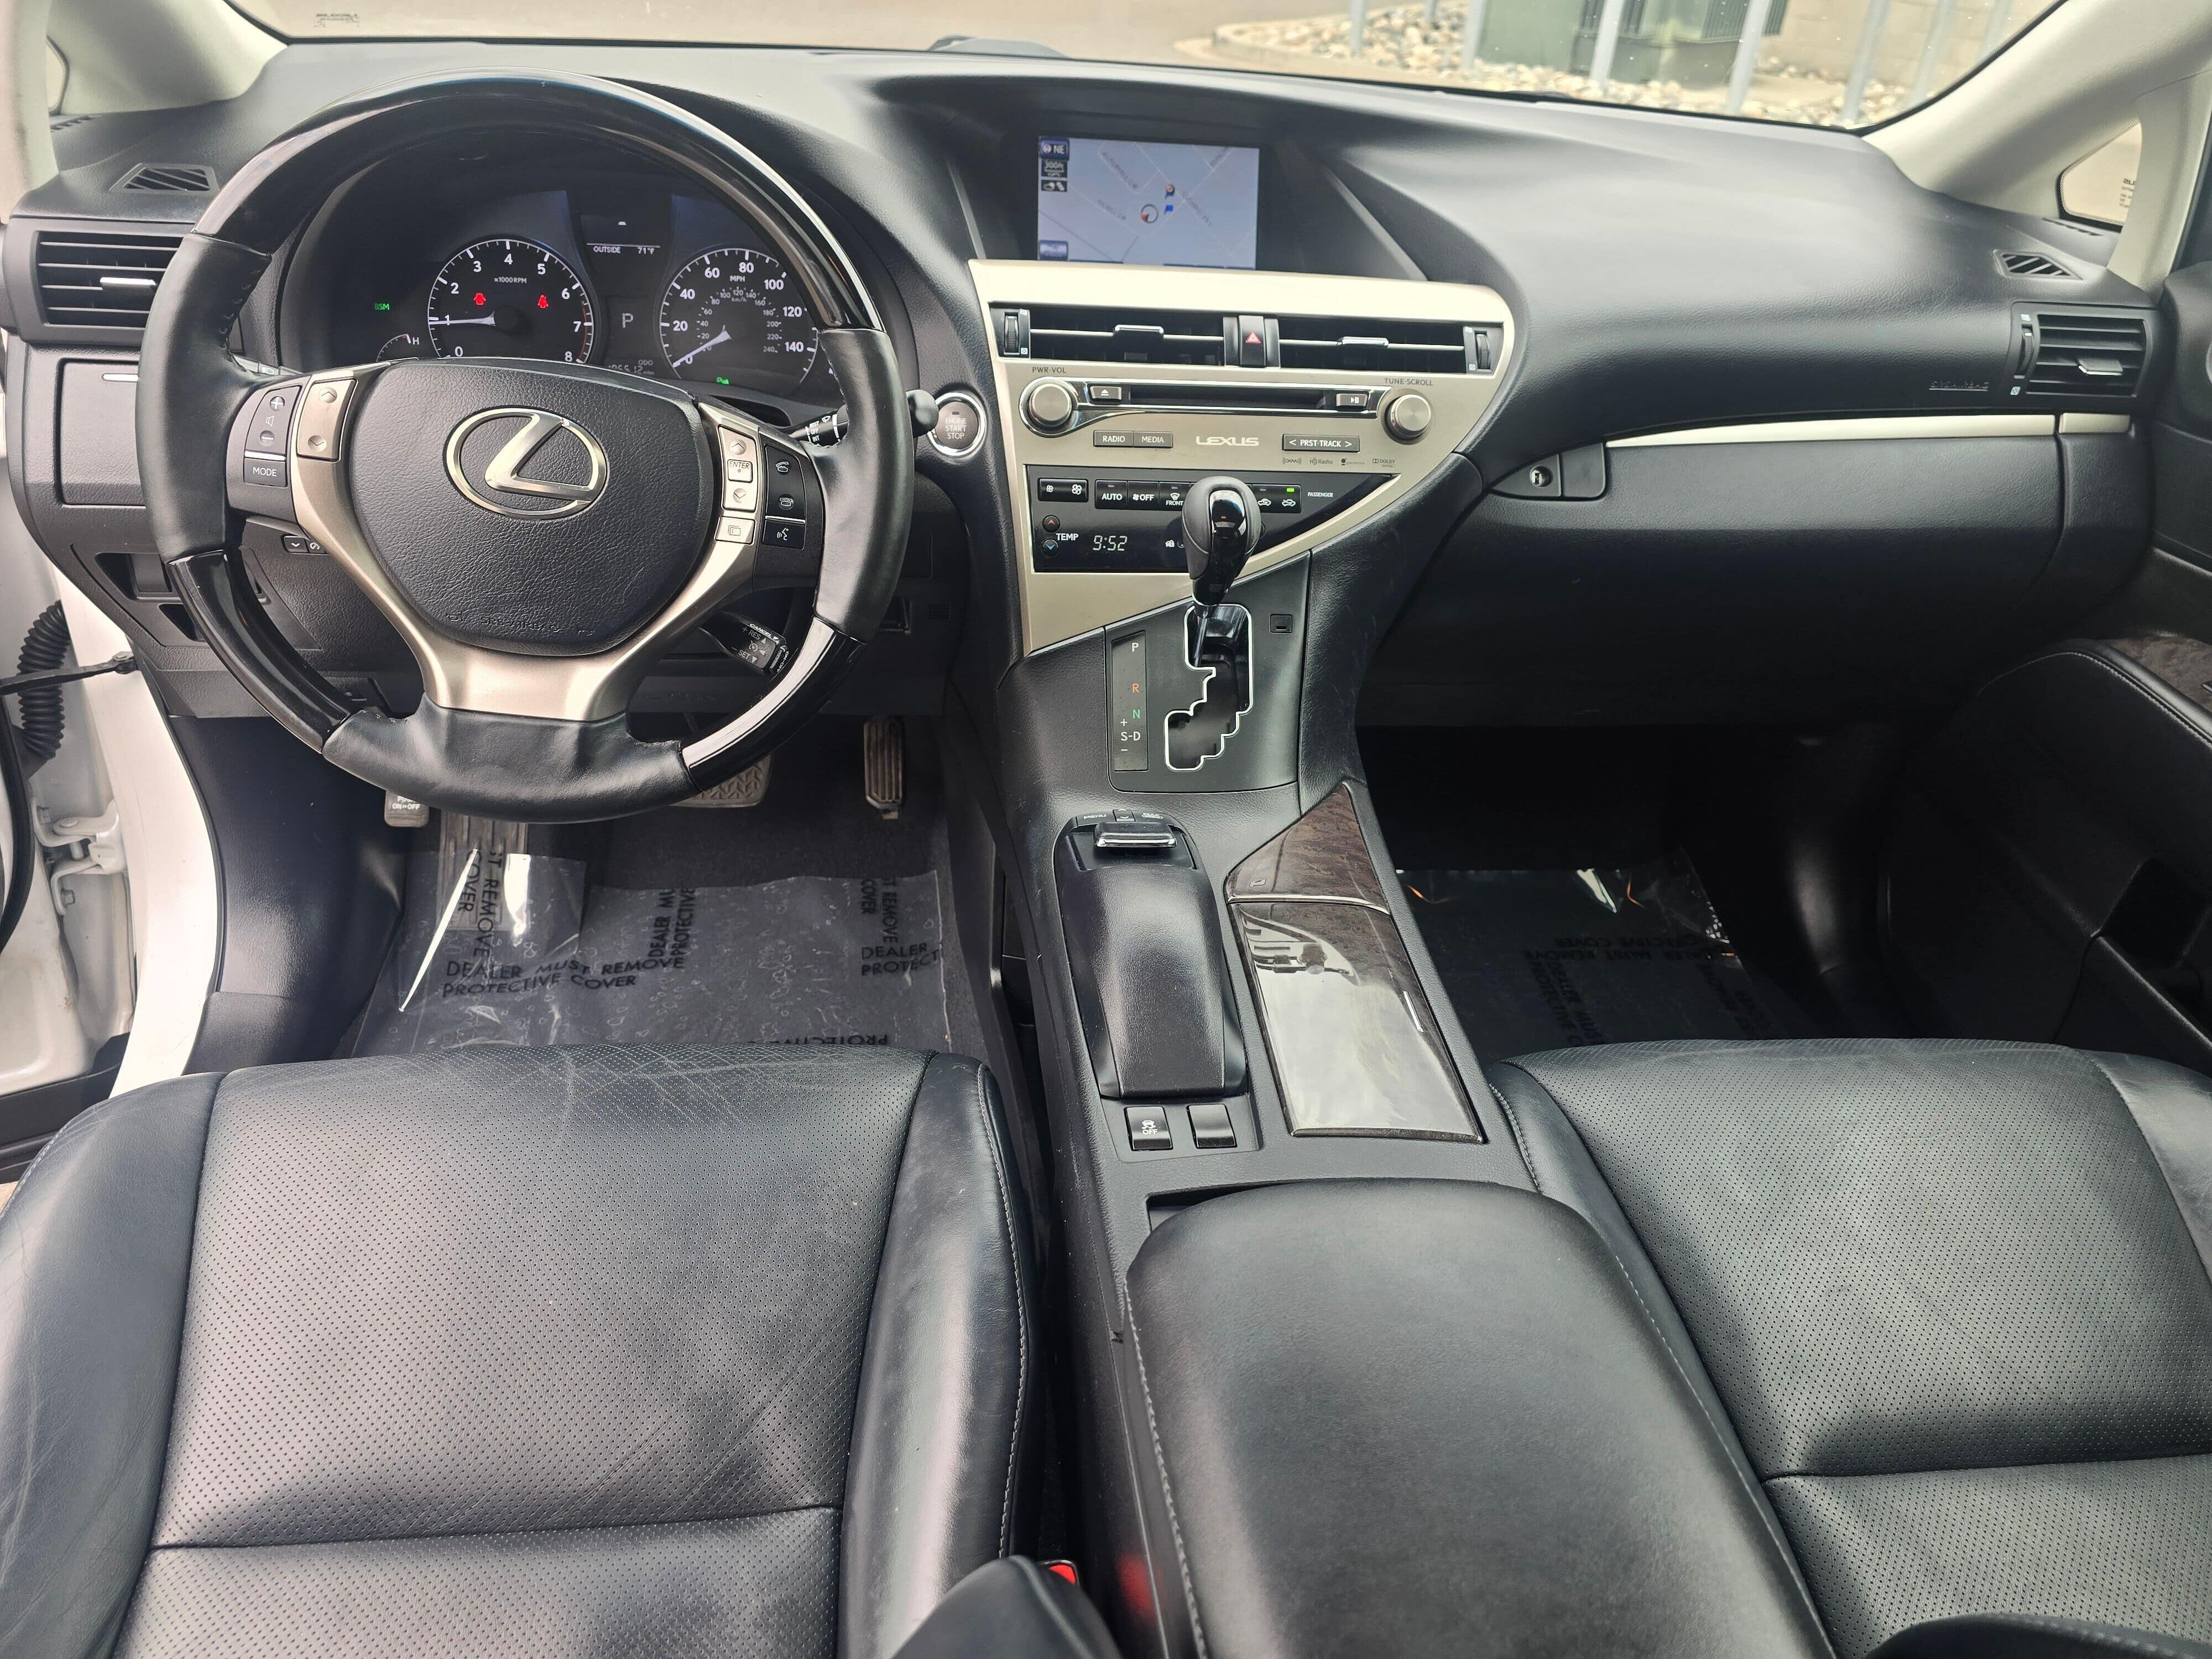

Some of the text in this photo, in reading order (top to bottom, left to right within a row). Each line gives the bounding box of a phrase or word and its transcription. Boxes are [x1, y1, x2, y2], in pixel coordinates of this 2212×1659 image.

[504, 254, 513, 264] 4
[473, 260, 482, 272] 3
[538, 263, 546, 274] 5
[739, 262, 754, 273] 80
[705, 267, 720, 278] 60
[451, 282, 459, 294] 2
[764, 279, 784, 290] 100
[561, 288, 570, 299] 6
[680, 289, 695, 299] 40
[783, 306, 802, 317] 120
[445, 315, 450, 325] 1
[622, 313, 634, 328] P
[573, 321, 581, 332] 7
[672, 321, 688, 331] 20
[455, 346, 463, 357] 0
[785, 342, 804, 352] 140
[564, 351, 573, 362] 8
[1196, 436, 1259, 446] LEXUS
[729, 461, 750, 469] ENTER
[253, 467, 277, 477] MODE
[1056, 533, 1128, 551] TEMP 9:52
[748, 629, 761, 640] RES
[749, 623, 772, 638] CANCEL
[1131, 642, 1139, 652] P
[738, 649, 751, 660] SET
[1132, 683, 1139, 693] R
[1133, 709, 1140, 719] N
[473, 877, 500, 958] REMOVE
[648, 916, 671, 958] DEALER
[861, 942, 927, 960] DEALER
[861, 948, 940, 976] PROTECT
[446, 957, 684, 979] DEALER MUST REMOVE
[443, 972, 637, 998] PROTECTIVE COVER
